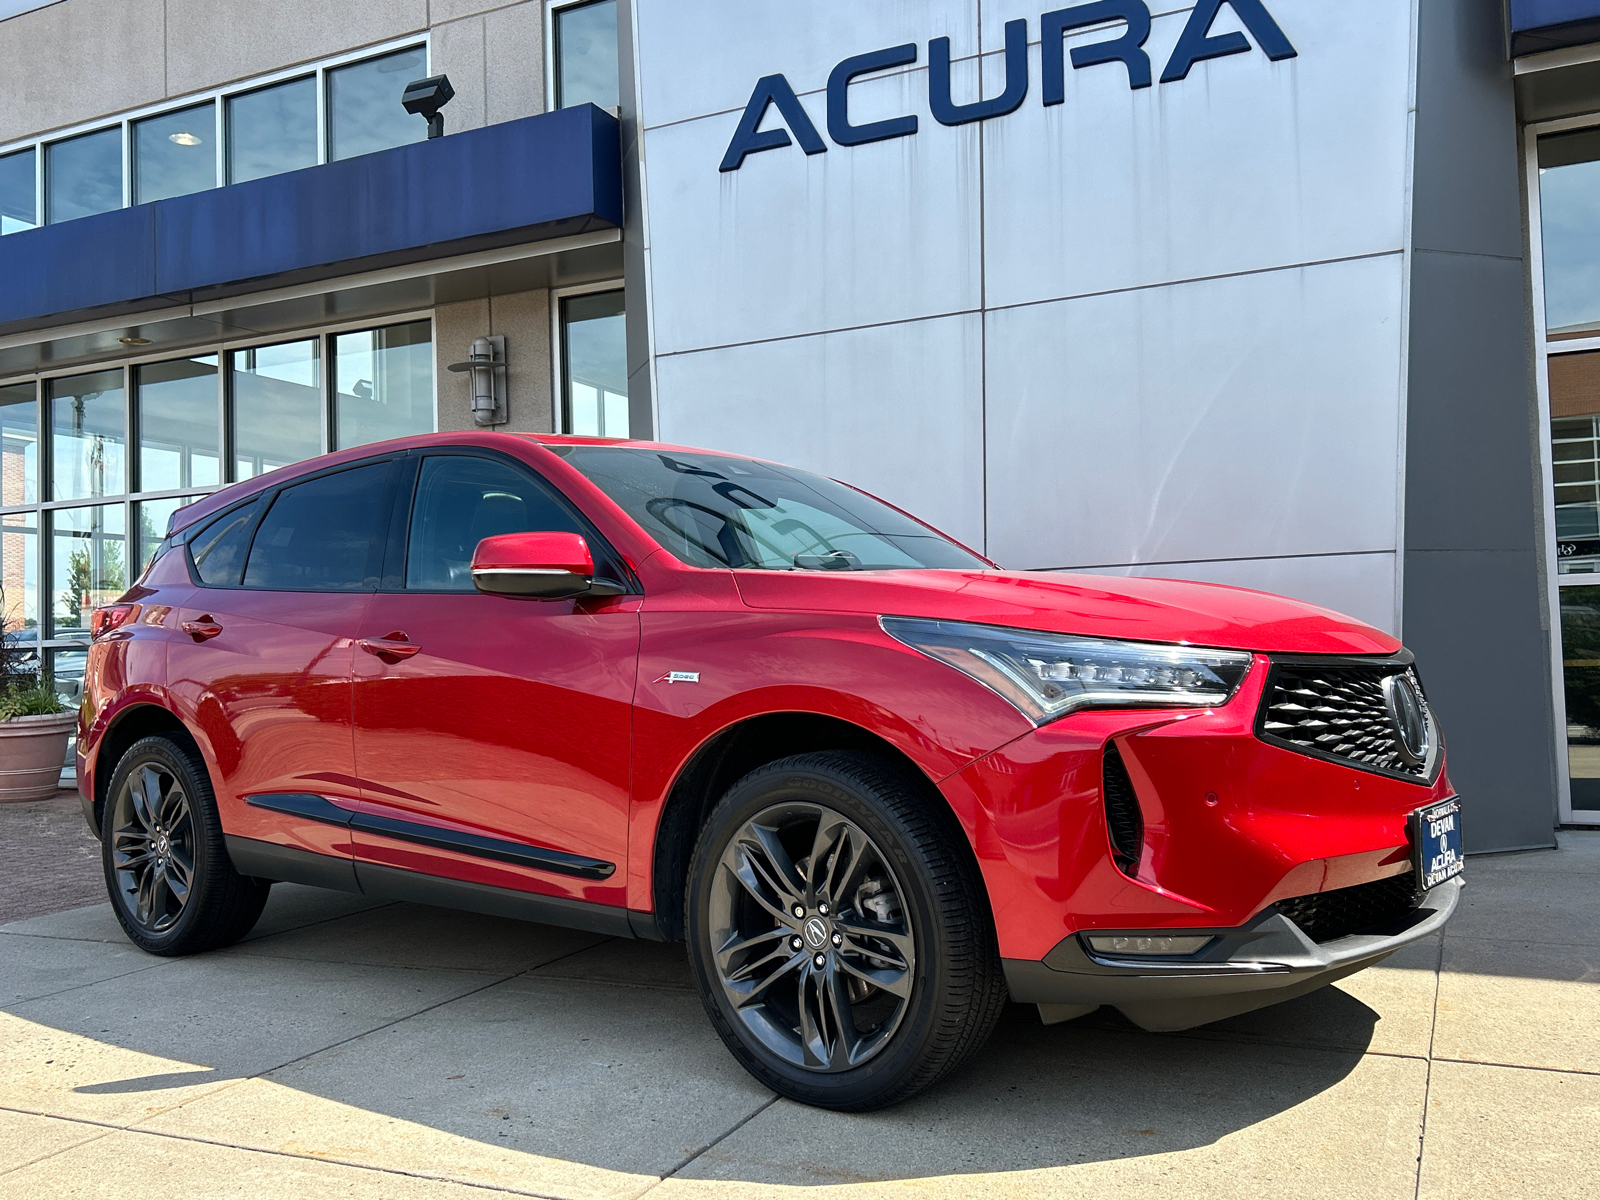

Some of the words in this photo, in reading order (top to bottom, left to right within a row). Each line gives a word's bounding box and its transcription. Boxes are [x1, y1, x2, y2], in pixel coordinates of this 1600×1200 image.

[719, 0, 1298, 172] ACURA
[787, 777, 908, 864] GOODYEAR
[1430, 815, 1455, 838] DEVAN
[1431, 849, 1456, 872] ACURA
